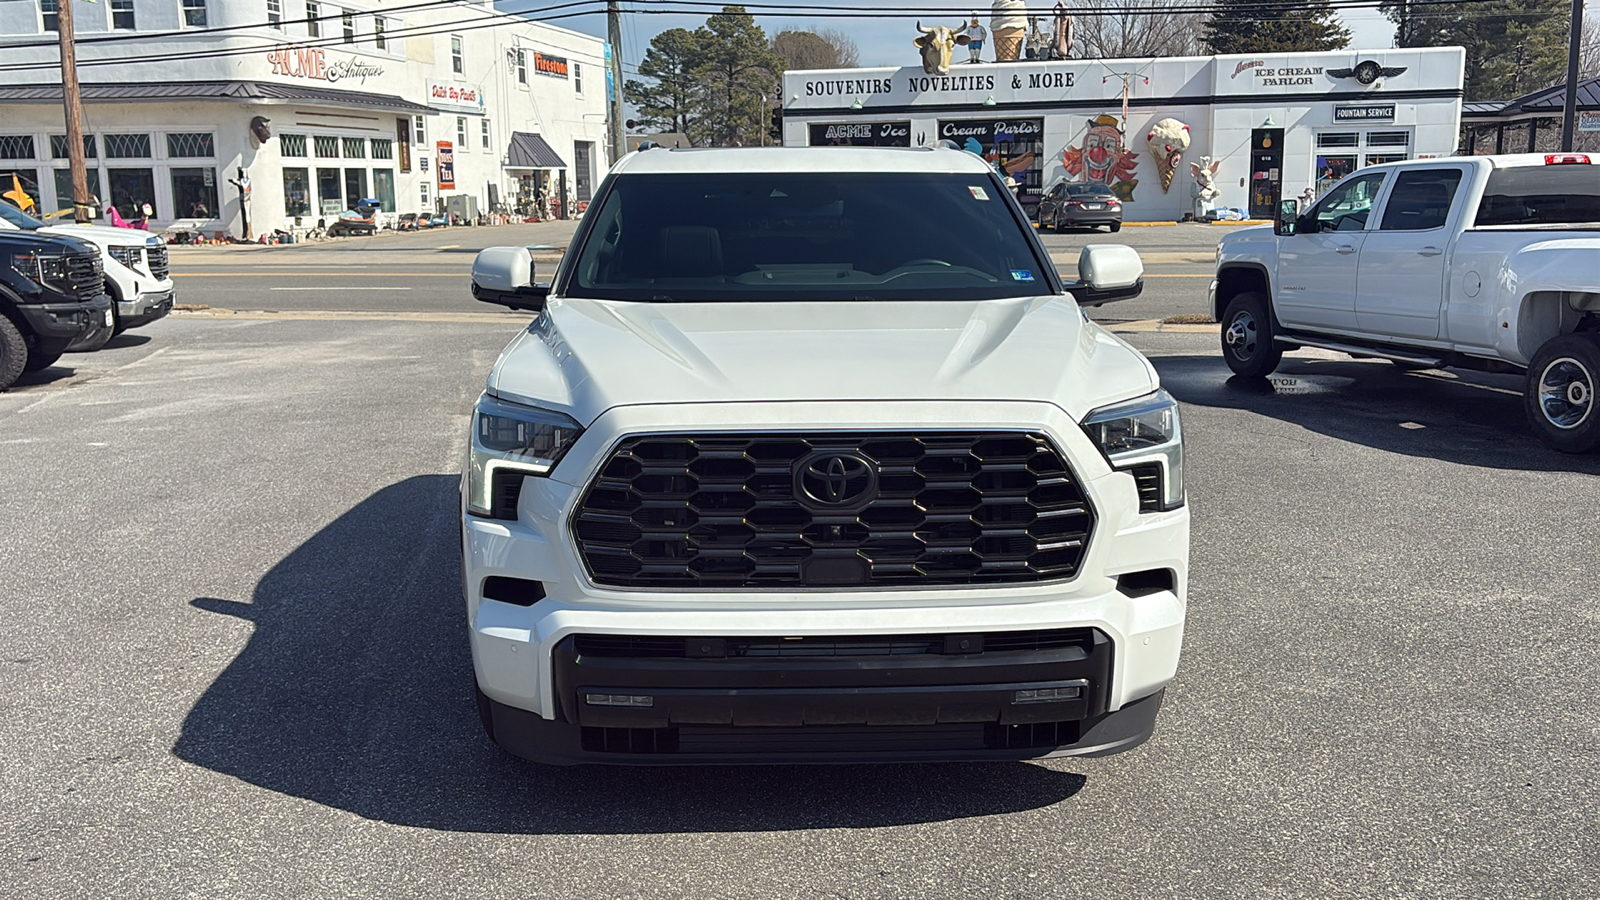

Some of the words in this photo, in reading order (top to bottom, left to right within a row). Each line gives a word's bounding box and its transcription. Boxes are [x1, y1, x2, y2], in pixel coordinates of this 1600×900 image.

[267, 44, 327, 80] ACME
[327, 55, 385, 85] Antiques
[1254, 68, 1275, 77] ICE
[1277, 67, 1323, 76] CREAM
[805, 79, 892, 96] SOUVENIRS
[908, 75, 994, 92] NOVELTIES
[1011, 74, 1022, 89] &
[1028, 72, 1075, 88] MORE
[1262, 77, 1314, 86] PARLOR
[432, 84, 447, 99] Dutch
[449, 86, 459, 103] Boy
[460, 88, 476, 102] Paints
[1336, 108, 1367, 118] FOUNTAIN
[1367, 107, 1393, 117] SERVICE
[825, 125, 872, 139] ACME
[880, 123, 908, 137] Ice
[942, 123, 988, 136] Cream
[994, 121, 1040, 135] Parlor
